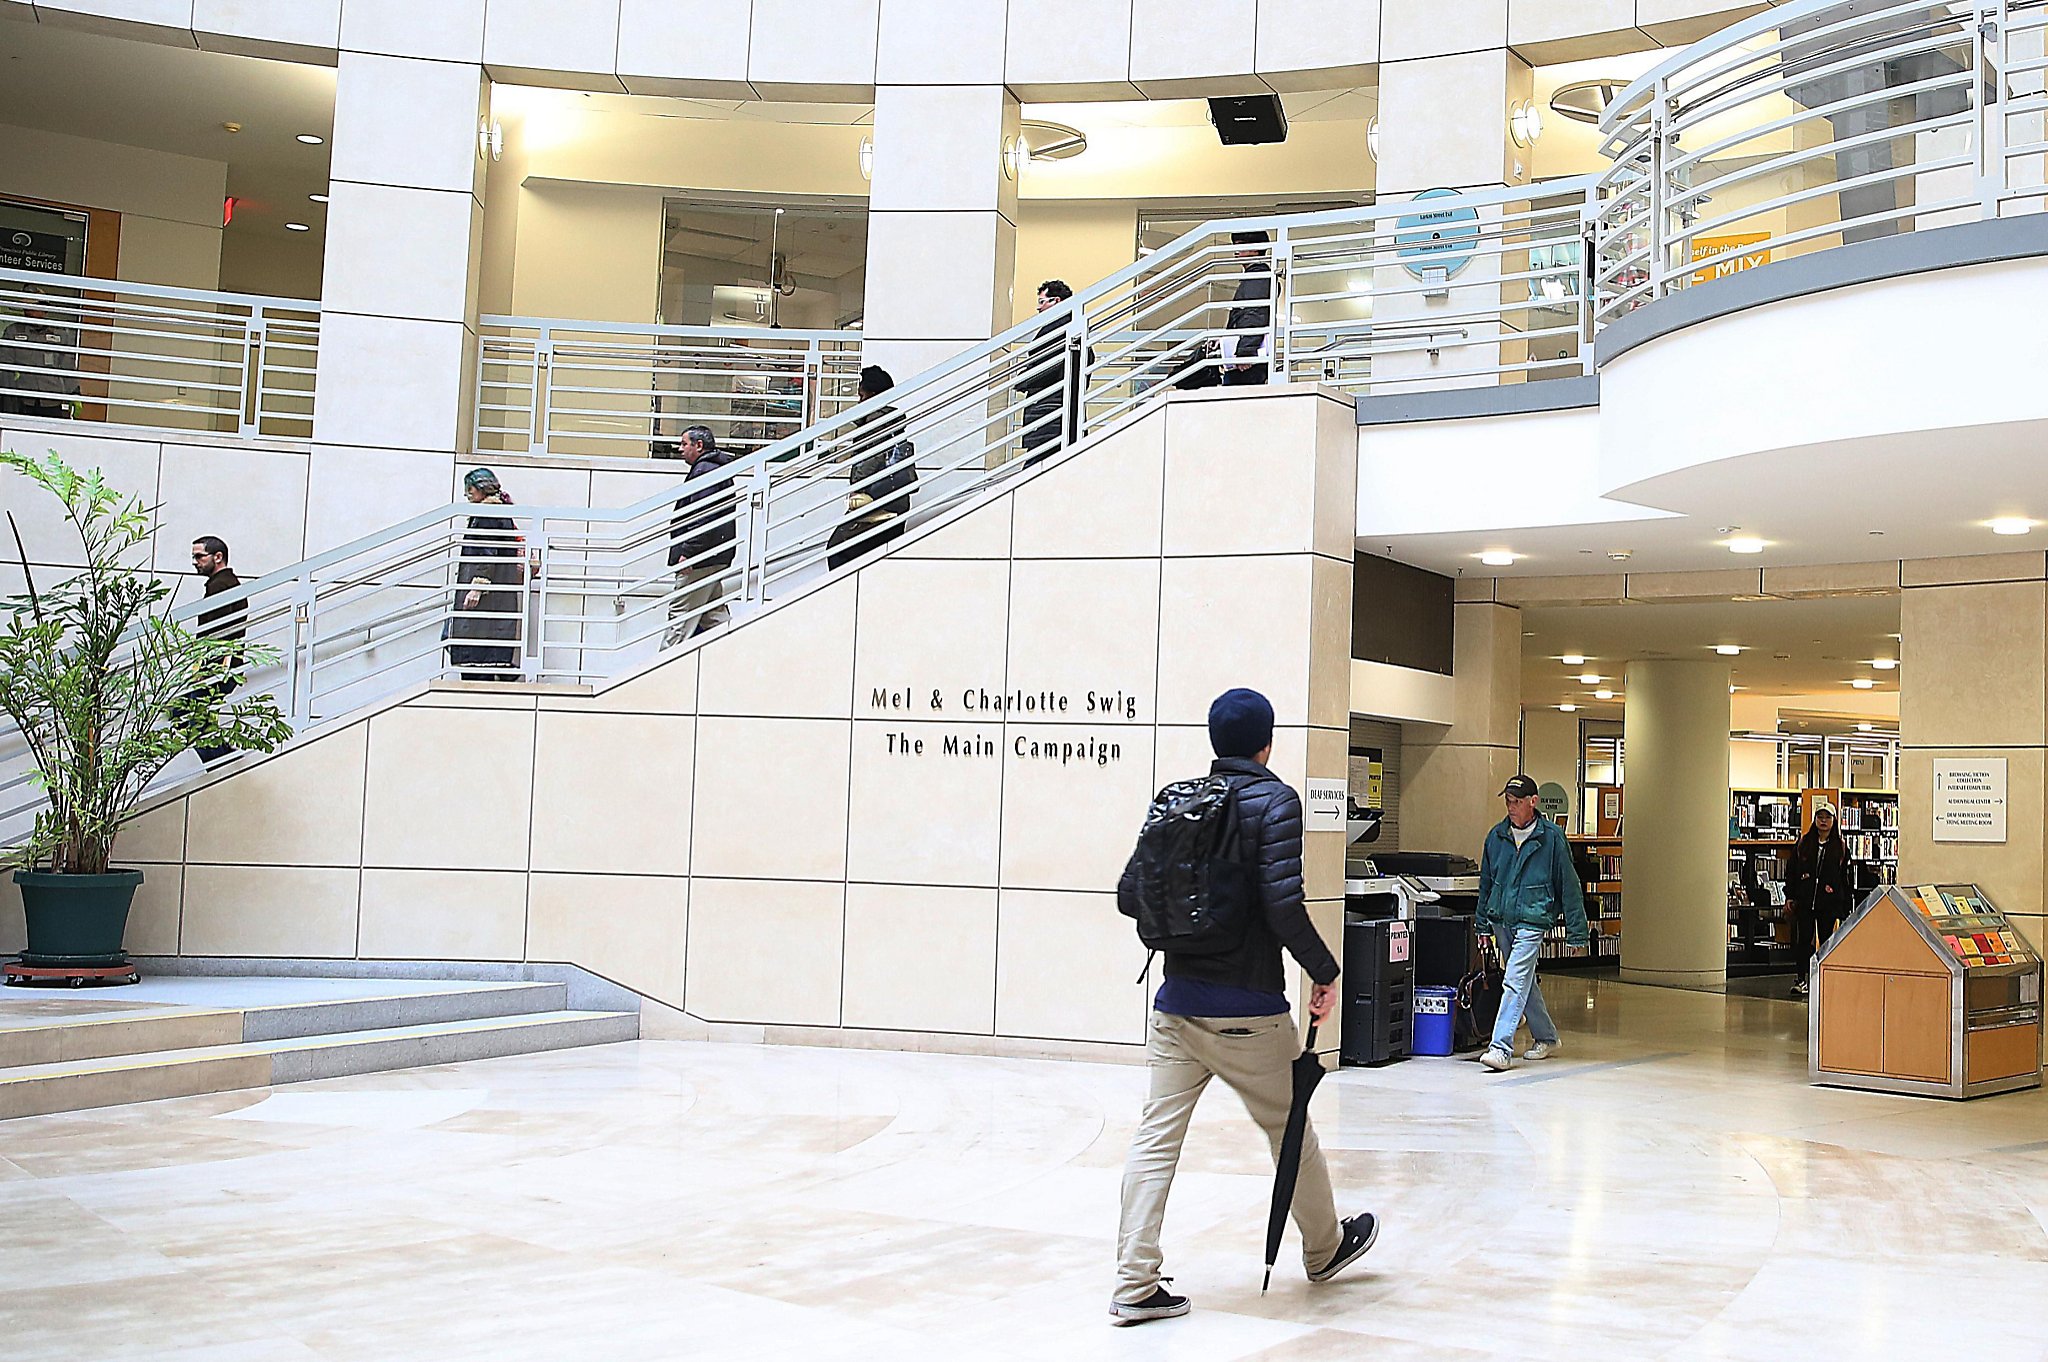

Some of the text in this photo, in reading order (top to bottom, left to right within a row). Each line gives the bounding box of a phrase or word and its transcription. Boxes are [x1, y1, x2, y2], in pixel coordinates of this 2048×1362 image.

[1708, 245, 1718, 255] in
[25, 256, 63, 270] Services
[871, 687, 1136, 720] Mel & Charlotte Swig
[886, 732, 1121, 766] The Main Campaign
[1310, 789, 1345, 801] DEAF SERVICES
